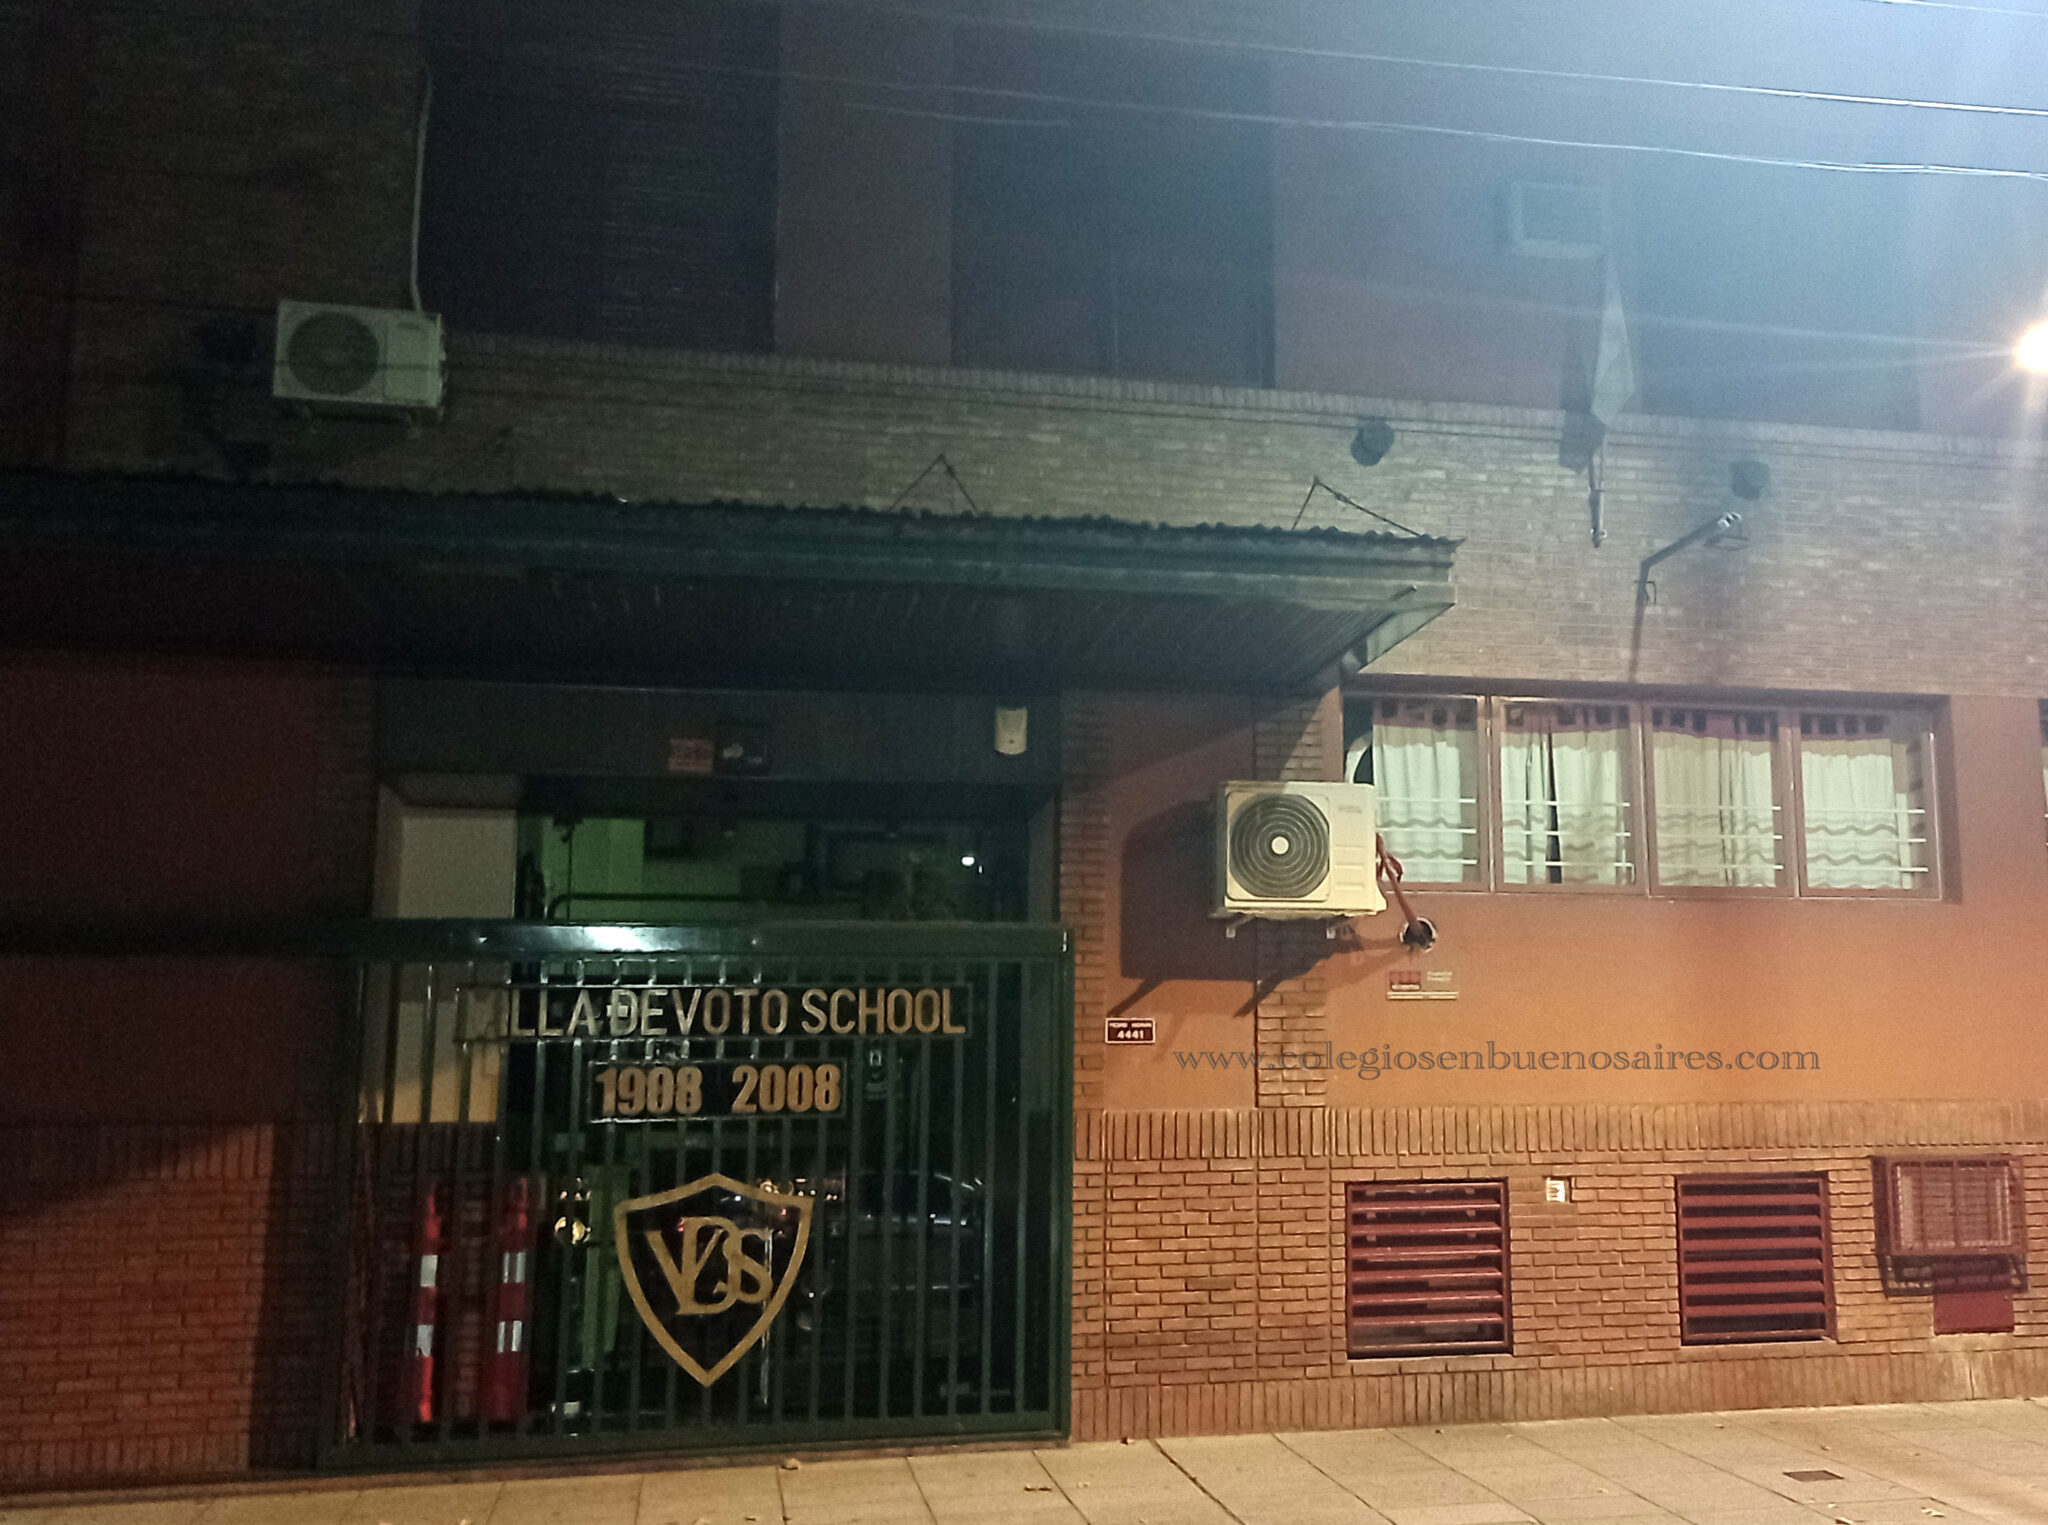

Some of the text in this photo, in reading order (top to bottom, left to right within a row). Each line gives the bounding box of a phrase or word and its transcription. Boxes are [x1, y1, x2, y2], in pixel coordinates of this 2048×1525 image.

[609, 988, 788, 1035] DEVOTO
[801, 988, 967, 1034] SCHOOL
[1117, 1030, 1144, 1039] 4441
[596, 1063, 842, 1116] 1908 2008
